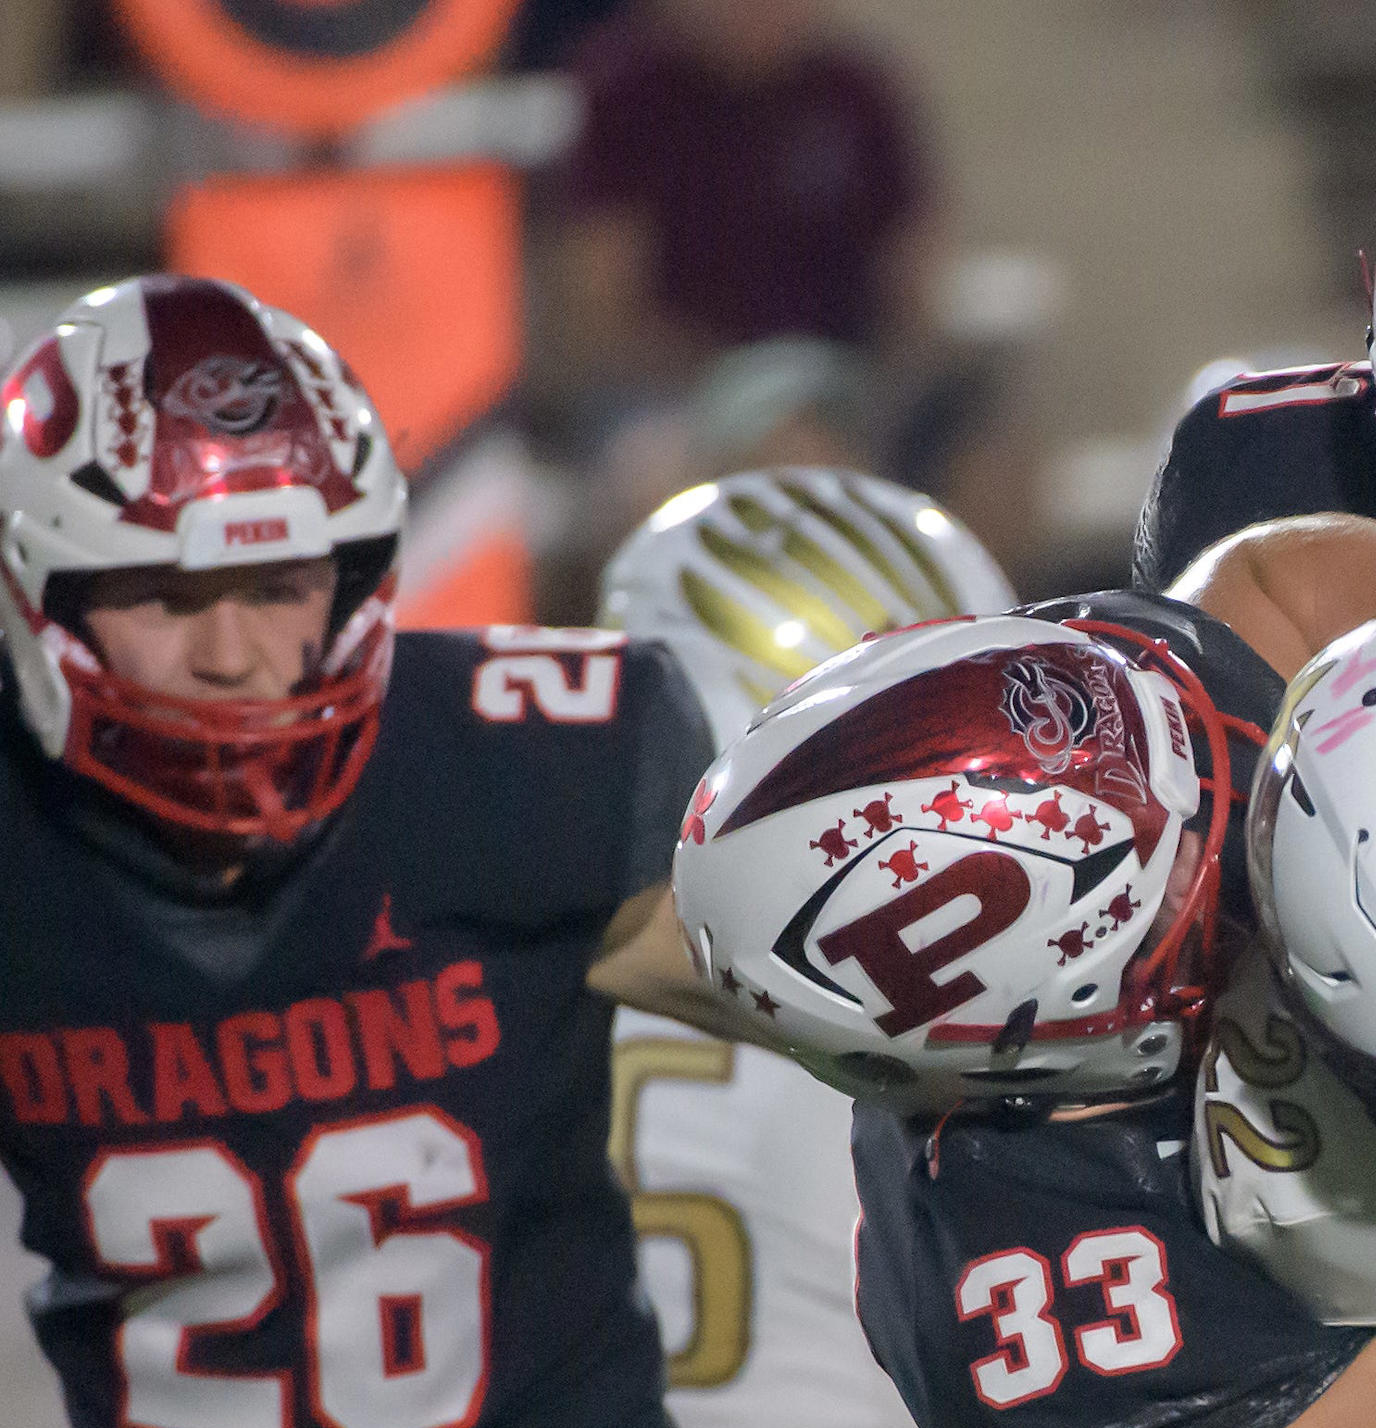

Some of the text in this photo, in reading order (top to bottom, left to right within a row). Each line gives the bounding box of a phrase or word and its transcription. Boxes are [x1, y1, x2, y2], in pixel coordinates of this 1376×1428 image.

[1160, 695, 1197, 761] PEKIN
[817, 852, 1031, 1038] P
[0, 960, 501, 1126] DRAGONS
[957, 1225, 1185, 1410] 33
